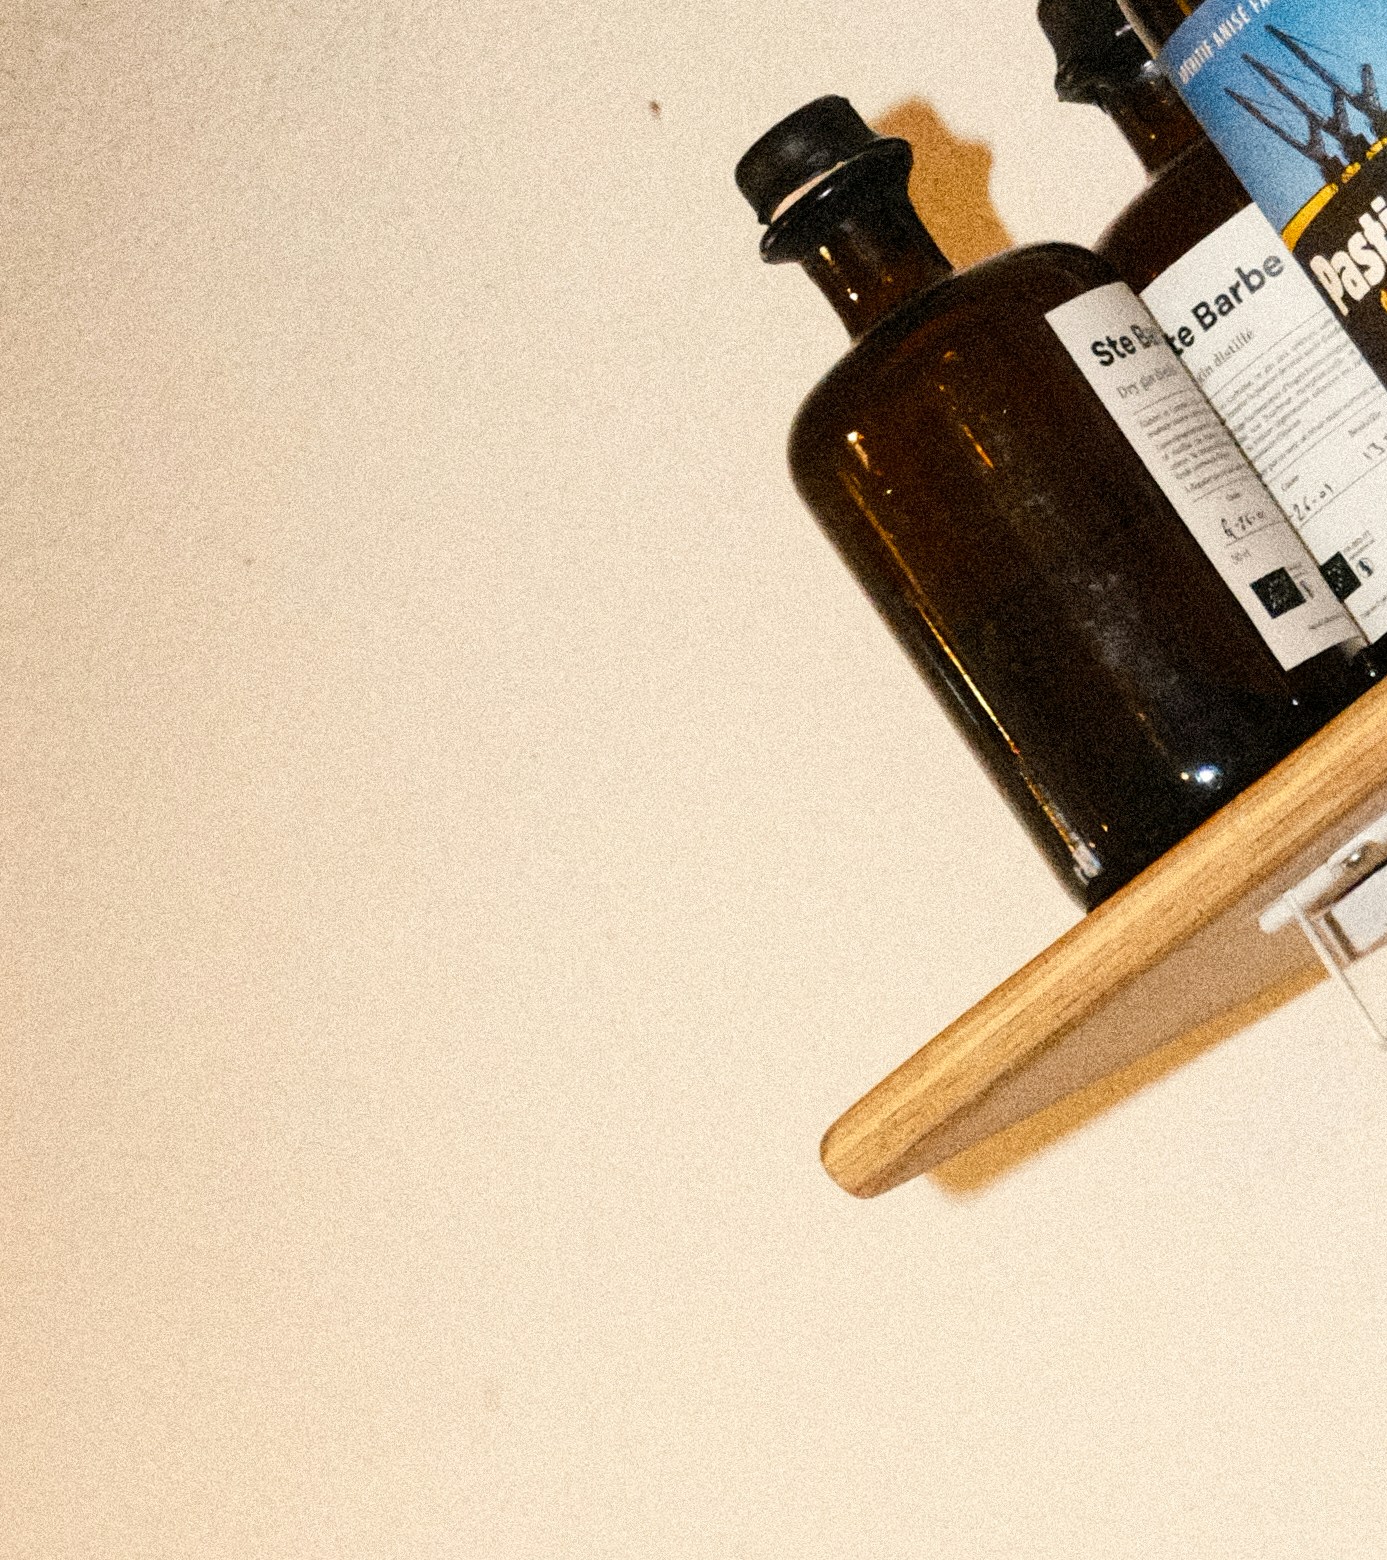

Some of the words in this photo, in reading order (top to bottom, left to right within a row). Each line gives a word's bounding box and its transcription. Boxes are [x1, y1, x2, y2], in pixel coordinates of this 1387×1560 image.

[1159, 326, 1195, 360] te
[1190, 256, 1284, 332] Barbe
[1090, 335, 1137, 367] Ste
